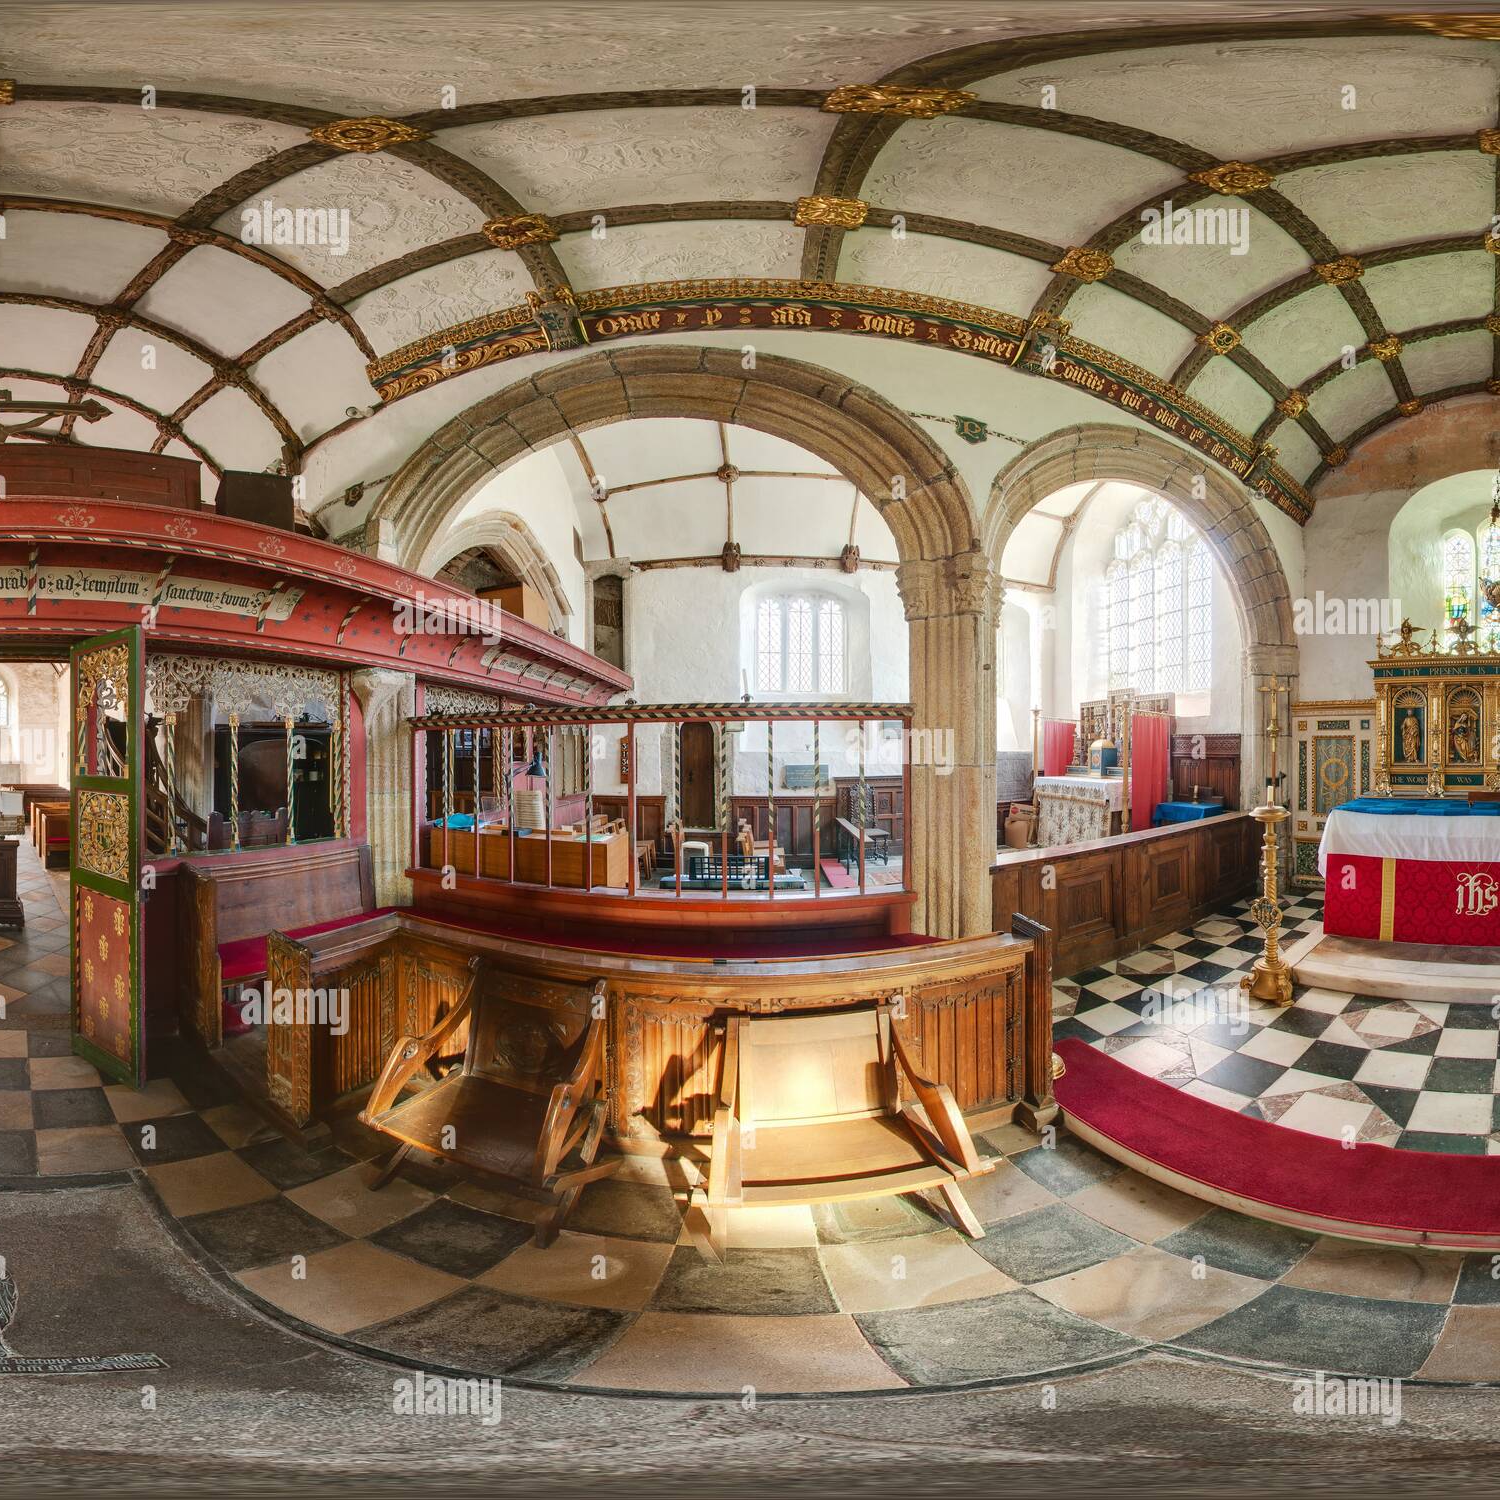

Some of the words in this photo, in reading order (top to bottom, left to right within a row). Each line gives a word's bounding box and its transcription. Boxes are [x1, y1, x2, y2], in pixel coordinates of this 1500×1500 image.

[1383, 668, 1394, 677] IN
[1401, 667, 1421, 676] THY
[1429, 667, 1469, 676] PRESENCE
[1478, 667, 1486, 675] IS
[1457, 775, 1473, 784] WAS
